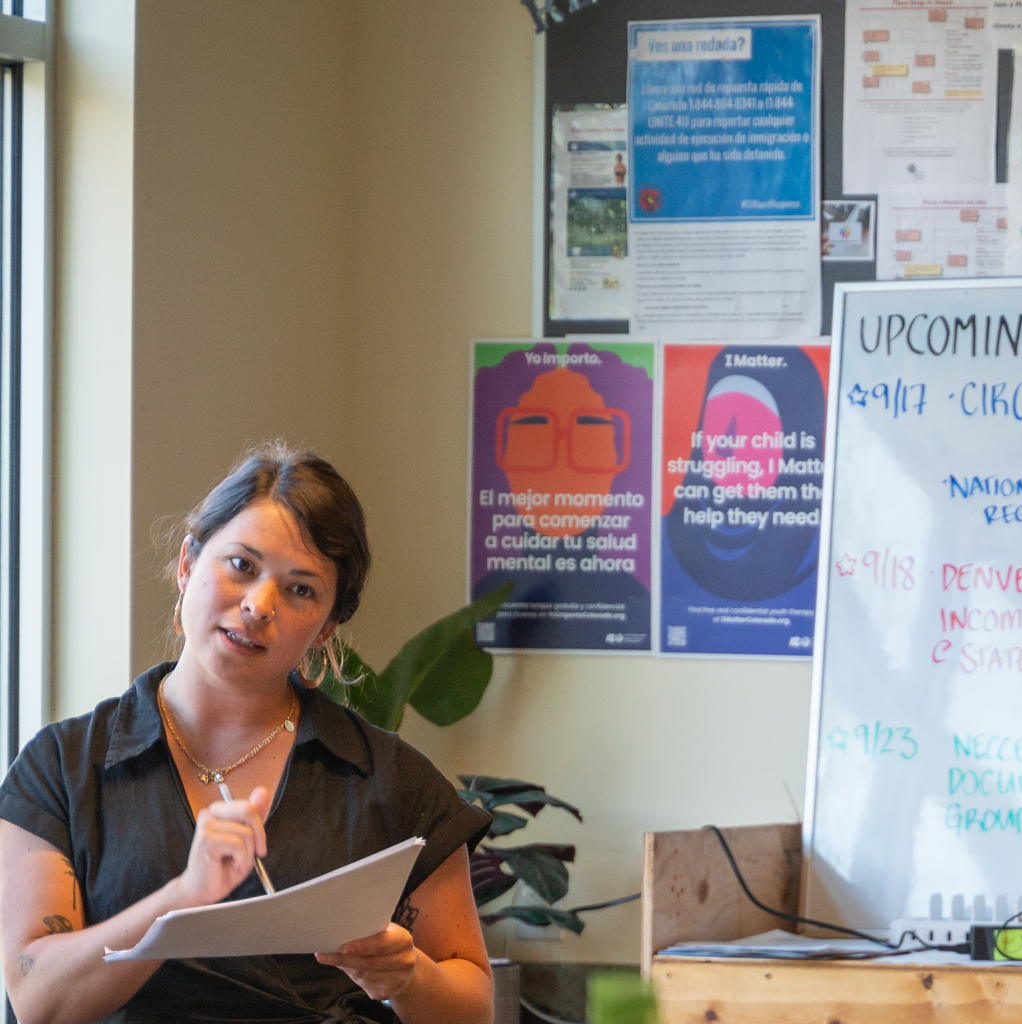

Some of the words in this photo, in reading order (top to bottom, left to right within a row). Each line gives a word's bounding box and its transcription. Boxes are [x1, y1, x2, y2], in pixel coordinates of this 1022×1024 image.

[672, 41, 692, 52] una
[696, 36, 746, 52] redada?
[525, 352, 541, 364] Yo
[543, 352, 603, 367] Importo.
[725, 354, 732, 367] I
[733, 354, 788, 368] Matter.
[871, 377, 928, 418] 9/17
[691, 431, 703, 448] If
[706, 435, 748, 453] your
[751, 432, 797, 448] child
[801, 431, 816, 448] is
[667, 457, 764, 479] struggling,
[479, 490, 493, 506] El
[498, 488, 550, 511] mejor
[554, 491, 645, 507] momento
[673, 484, 709, 499] can
[712, 484, 743, 504] get
[747, 483, 797, 499] them
[801, 483, 823, 499] th
[492, 514, 535, 532] para
[539, 514, 631, 529] comenzar
[683, 507, 724, 530] help
[727, 507, 769, 530] they
[485, 535, 497, 549] a
[501, 532, 559, 549] cuidar
[564, 535, 582, 549] tu
[586, 533, 637, 550] salud
[486, 554, 551, 571] mental
[555, 557, 576, 571] es
[580, 555, 636, 572] ahora
[862, 547, 915, 590] 9/18
[855, 720, 919, 760] 9/23
